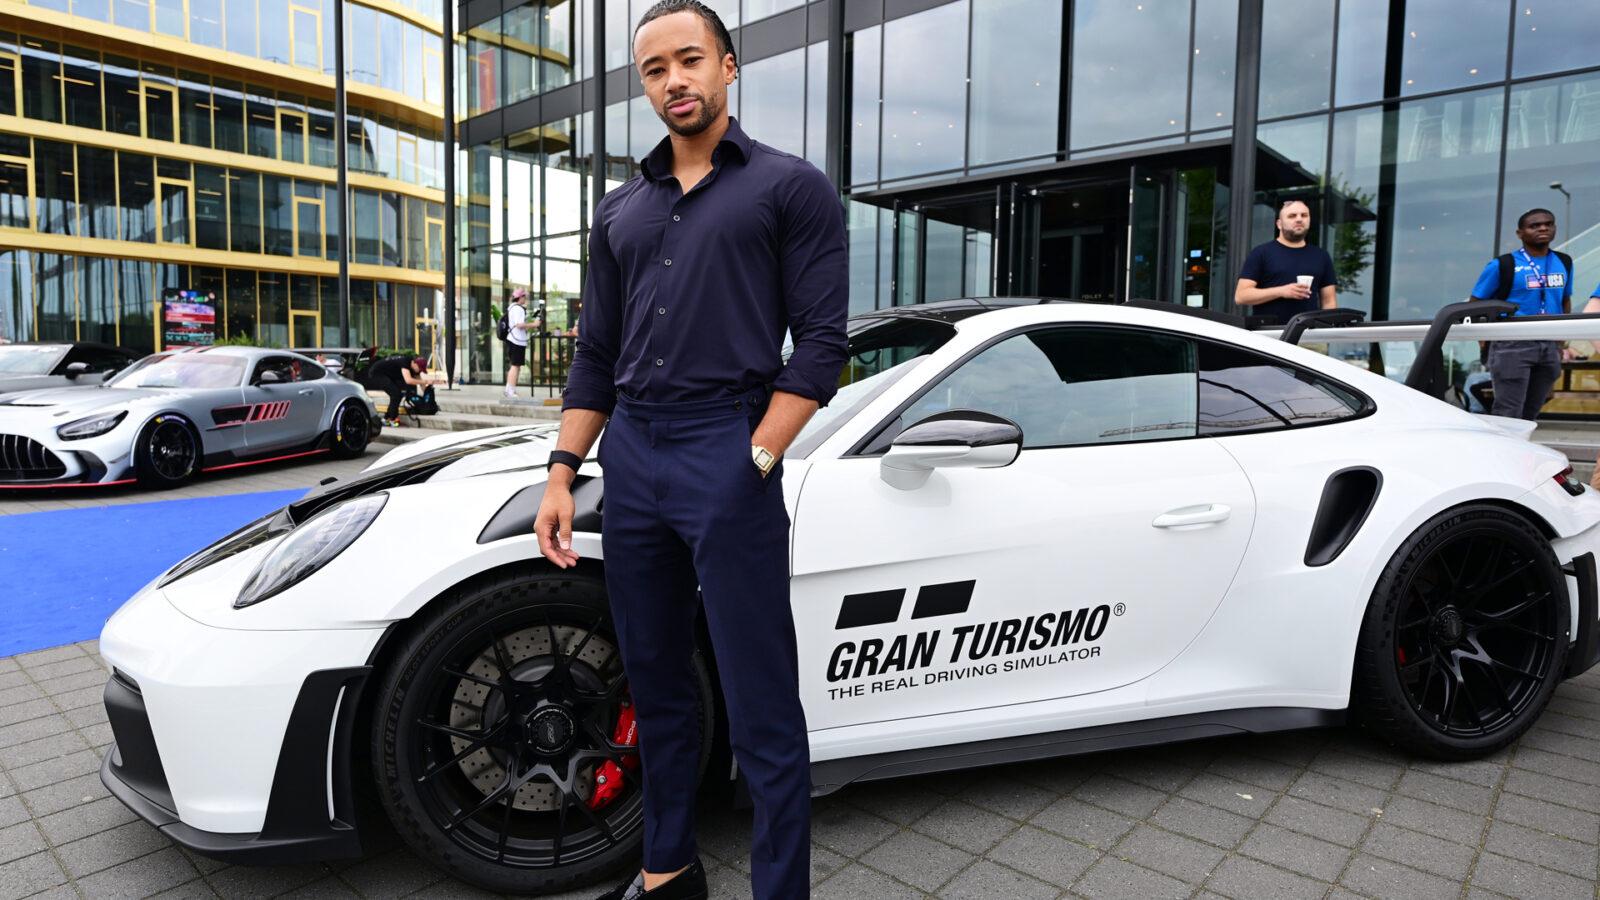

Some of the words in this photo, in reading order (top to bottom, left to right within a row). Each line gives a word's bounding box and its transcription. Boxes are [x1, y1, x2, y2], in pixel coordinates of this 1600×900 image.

[1548, 274, 1564, 287] USA
[826, 630, 940, 682] GRAN
[828, 685, 865, 700] THE
[871, 677, 919, 694] REAL
[925, 664, 998, 685] DRIVING
[1004, 646, 1101, 672] SIMULATOR
[384, 688, 406, 779] MICHELIN
